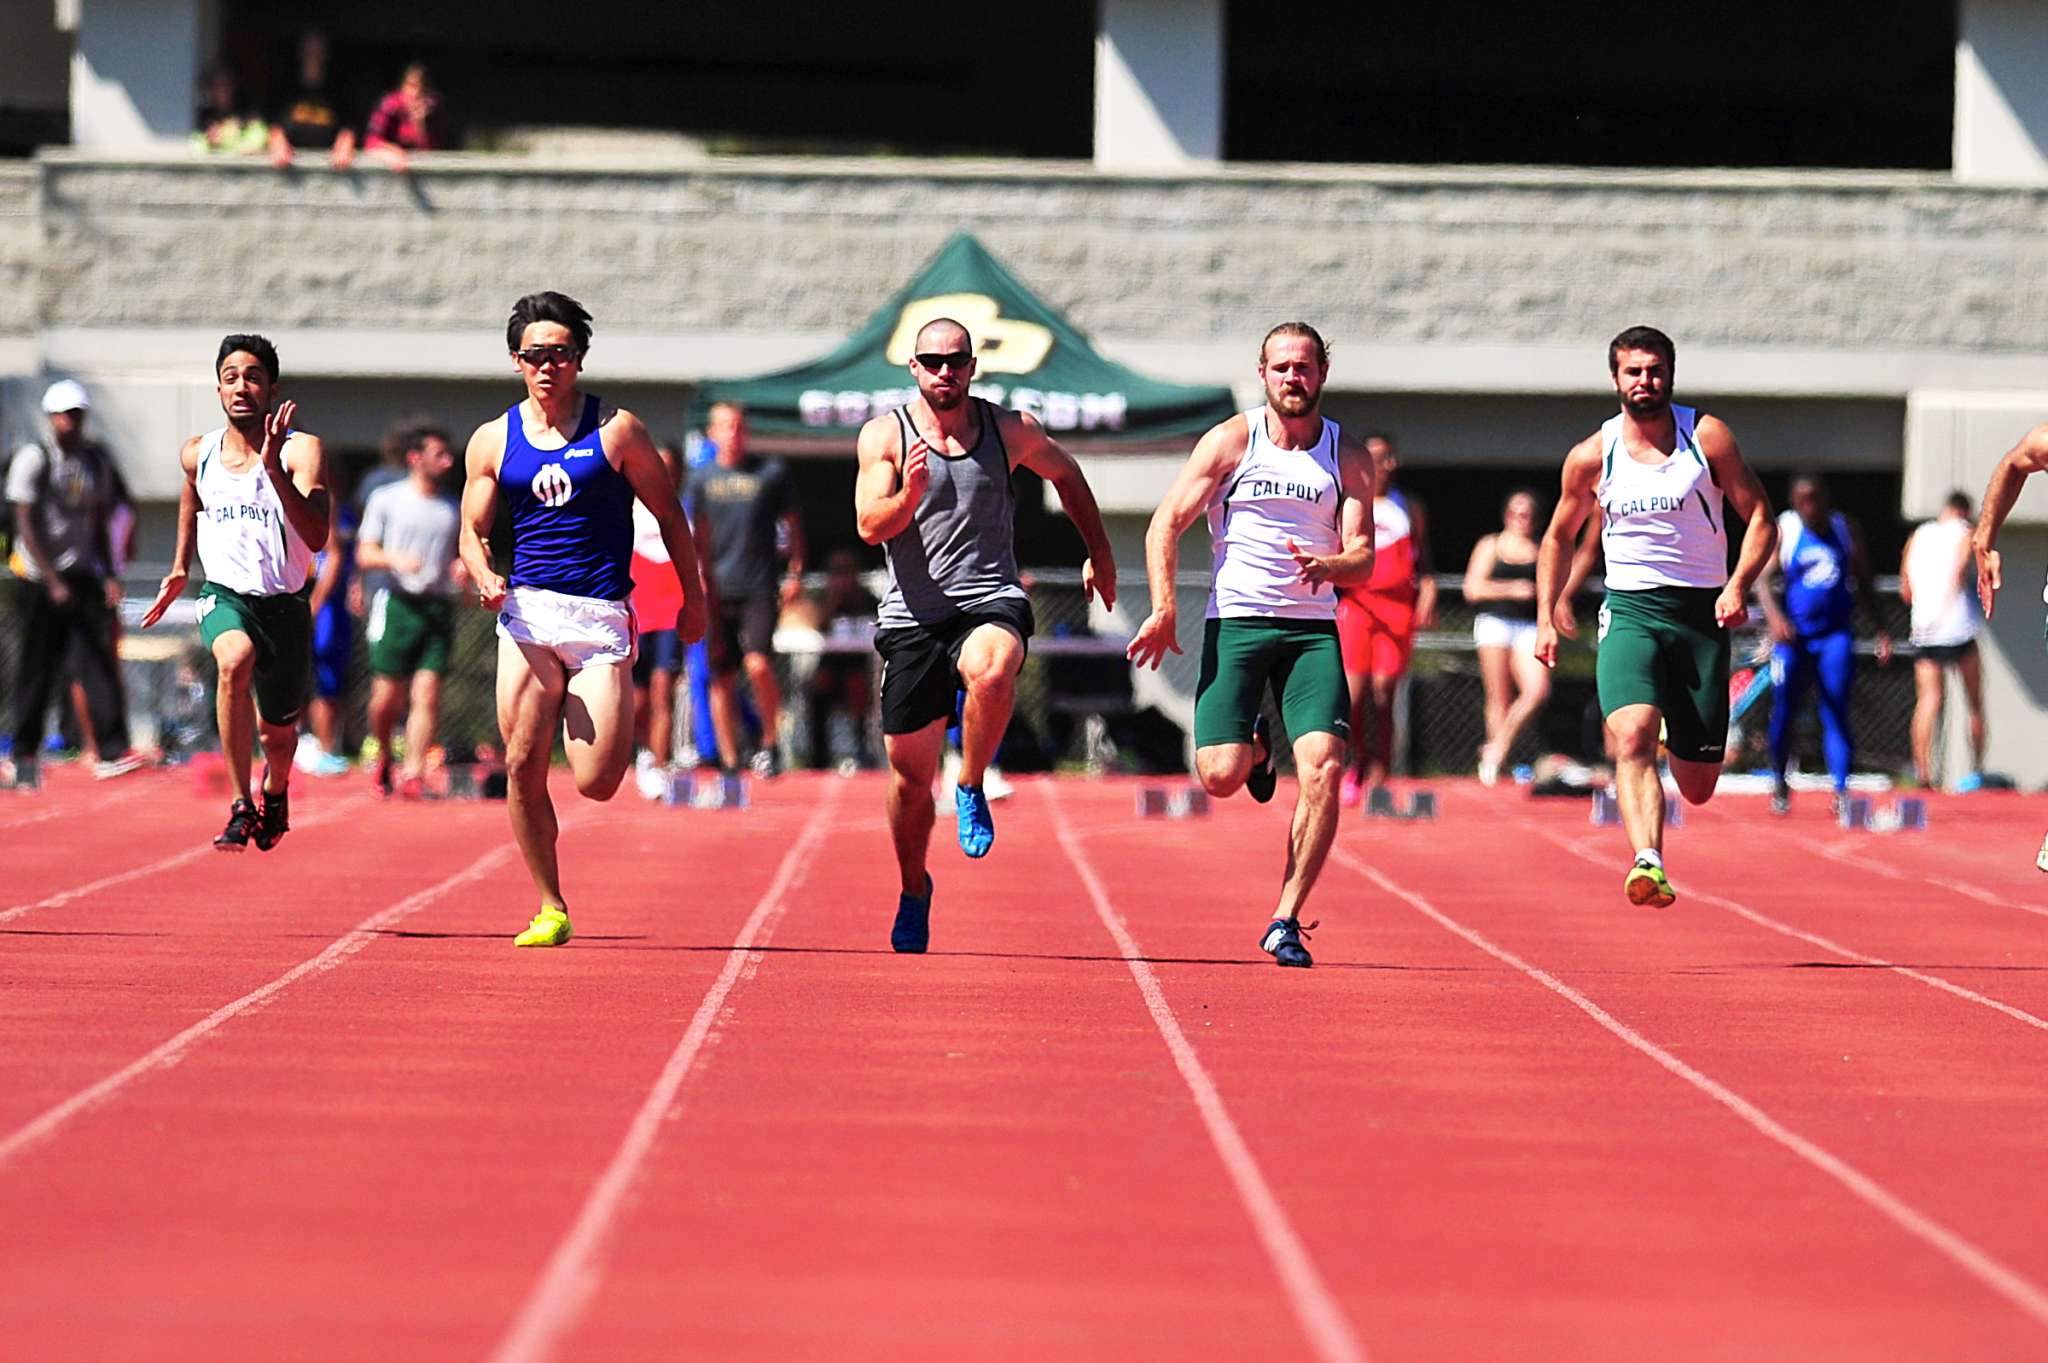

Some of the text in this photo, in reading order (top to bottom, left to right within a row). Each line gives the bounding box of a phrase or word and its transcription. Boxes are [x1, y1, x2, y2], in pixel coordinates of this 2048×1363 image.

[1253, 481, 1323, 504] CAL POLY
[216, 504, 269, 528] CAL POLY
[1621, 496, 1685, 517] CAL POLY
